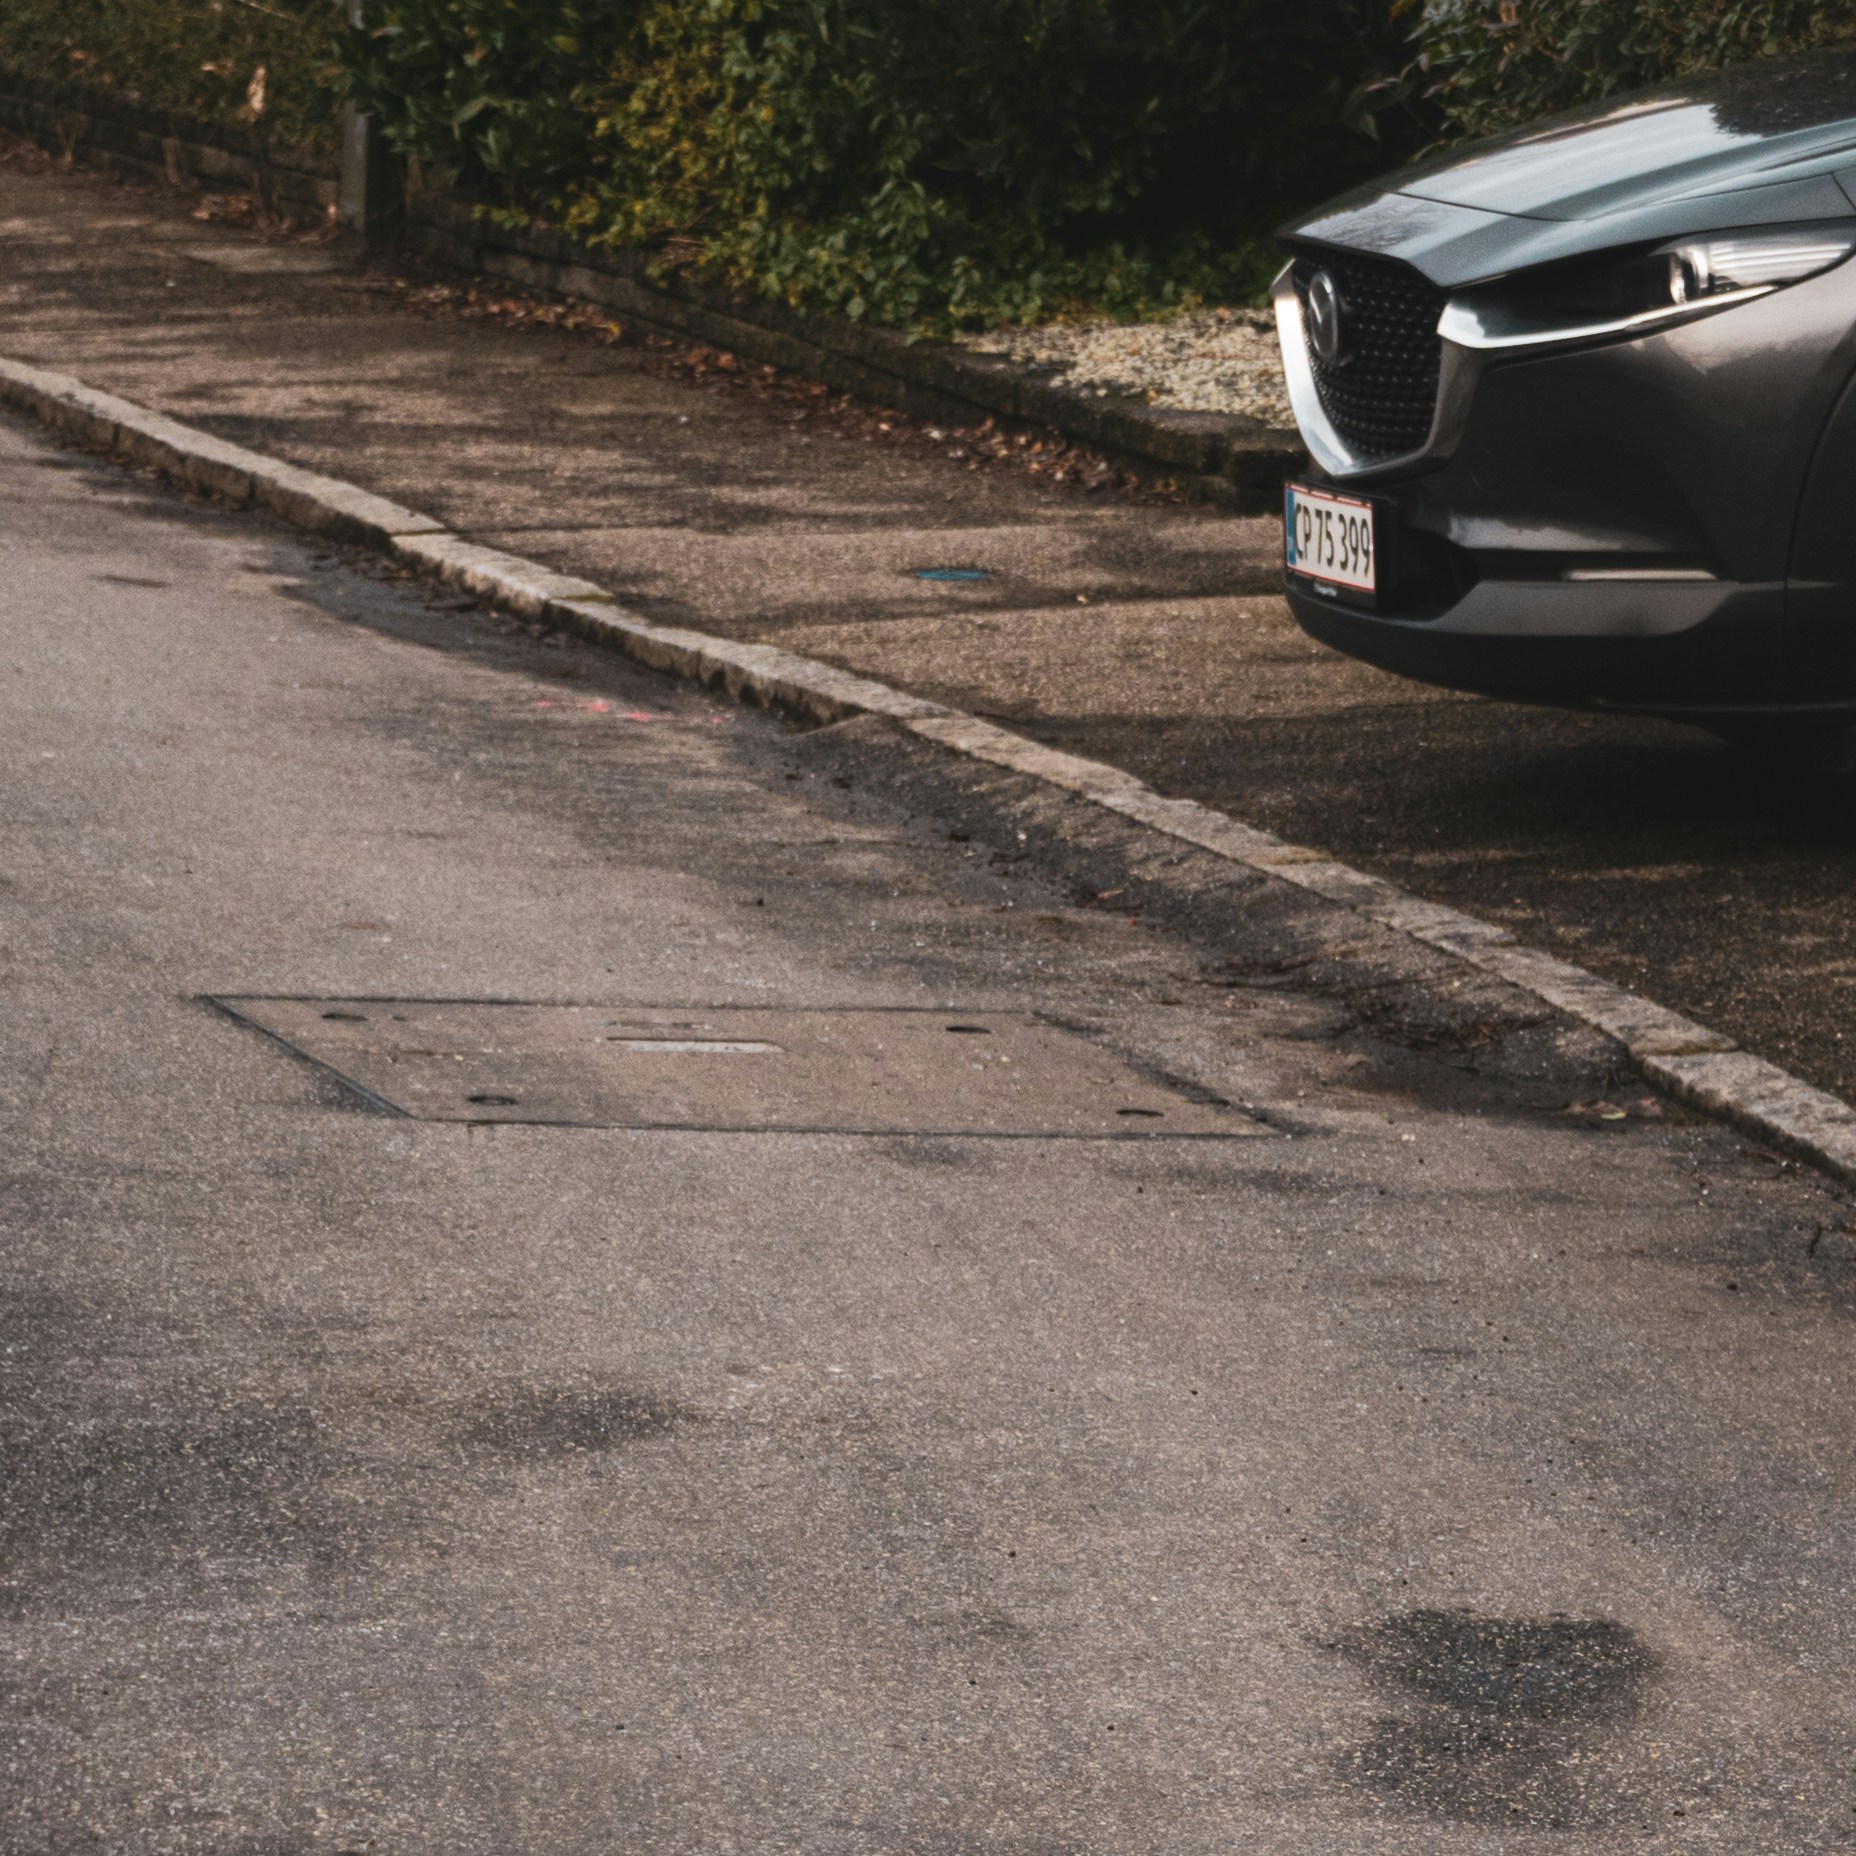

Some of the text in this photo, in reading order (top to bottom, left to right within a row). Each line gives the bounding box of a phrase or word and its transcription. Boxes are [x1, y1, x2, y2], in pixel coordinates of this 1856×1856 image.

[1296, 503, 1370, 578] CP 75 399
